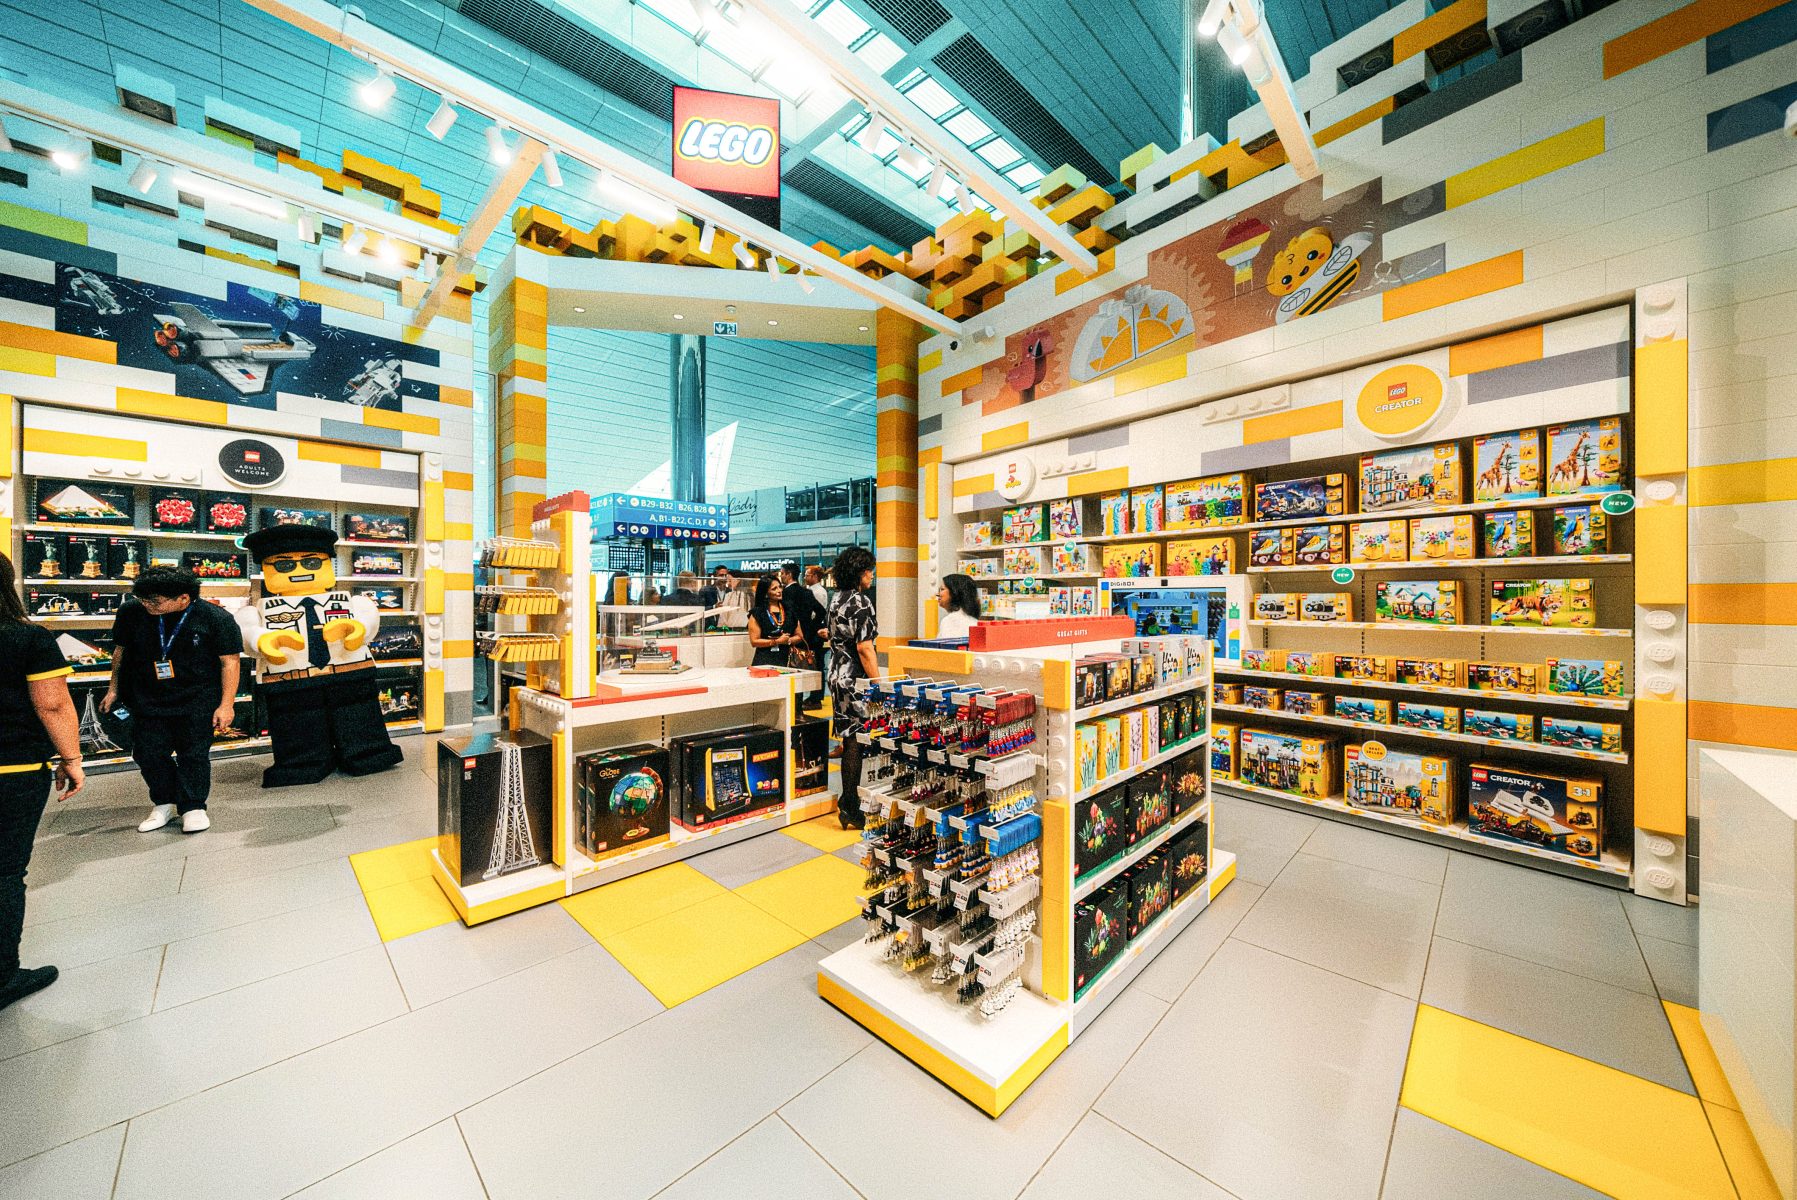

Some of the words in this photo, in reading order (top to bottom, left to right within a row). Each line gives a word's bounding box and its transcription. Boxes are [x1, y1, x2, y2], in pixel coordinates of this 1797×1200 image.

[677, 118, 775, 167] LEGO
[1389, 387, 1406, 397] LEGO
[1375, 397, 1422, 413] CREATOR
[694, 505, 707, 513] B28
[1057, 630, 1073, 638] GREAT
[1490, 774, 1531, 787] CREATOR
